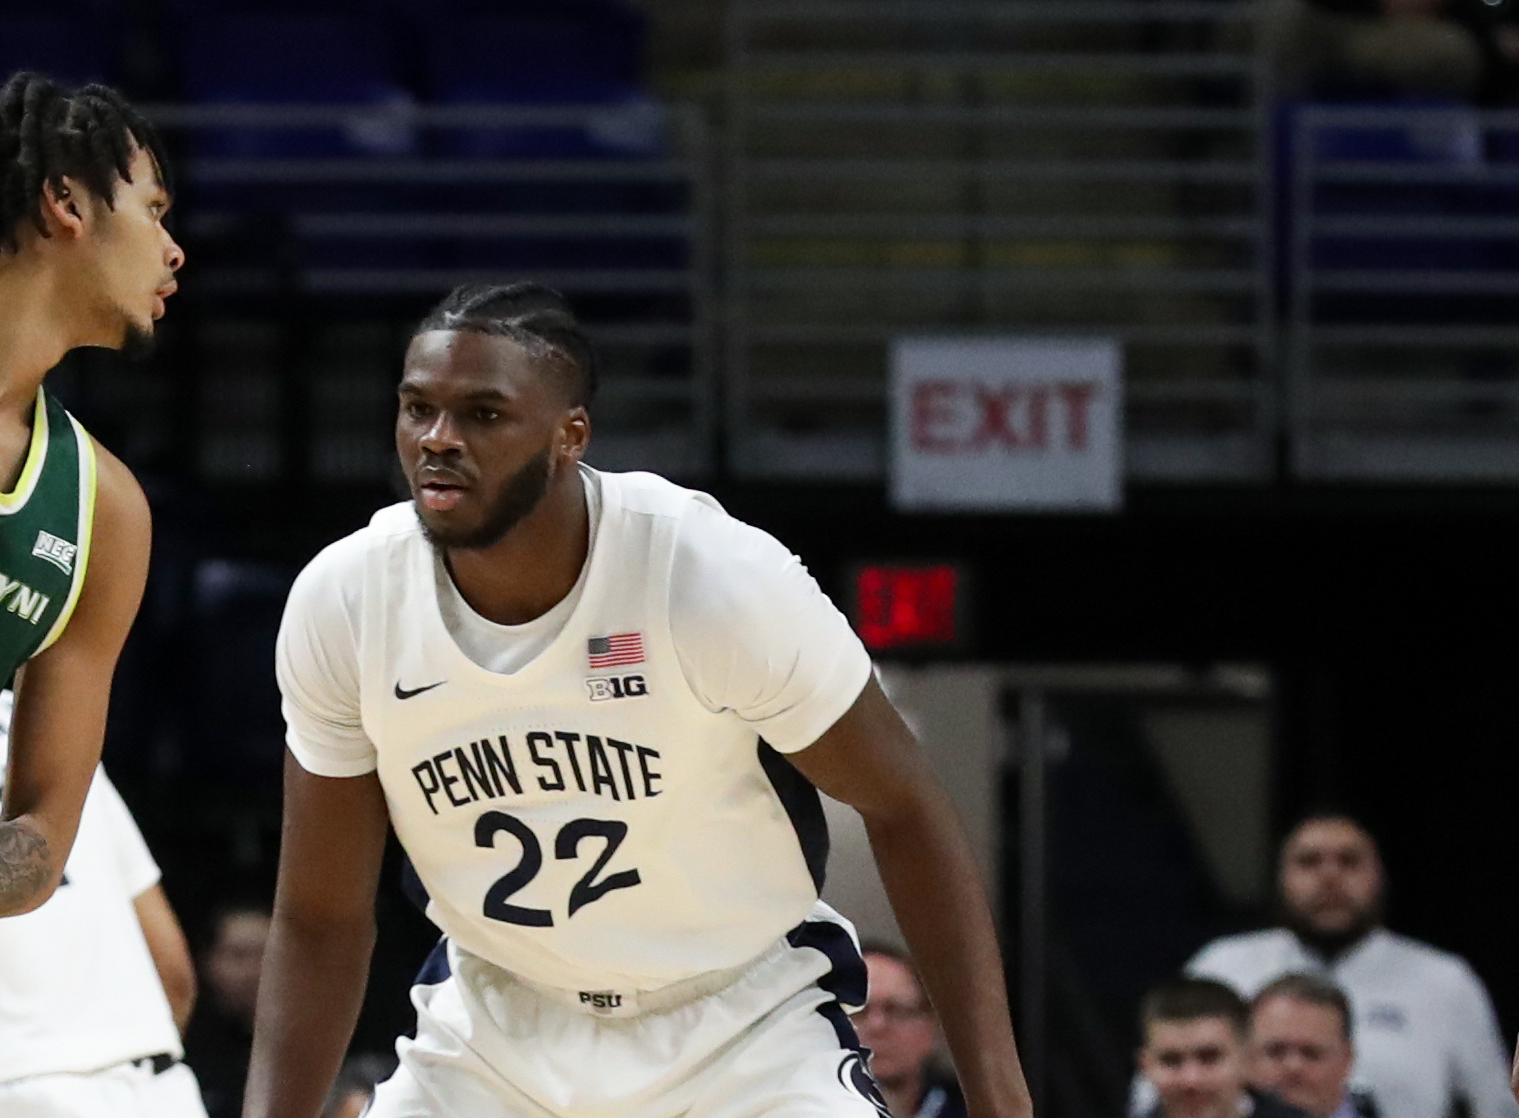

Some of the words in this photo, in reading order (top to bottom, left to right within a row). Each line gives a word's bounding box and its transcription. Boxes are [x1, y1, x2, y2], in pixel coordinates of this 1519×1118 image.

[910, 379, 1098, 454] EXIT
[411, 735, 524, 816] PENN
[526, 730, 663, 802] STATE
[473, 810, 642, 928] 22
[578, 991, 622, 1008] PSU
